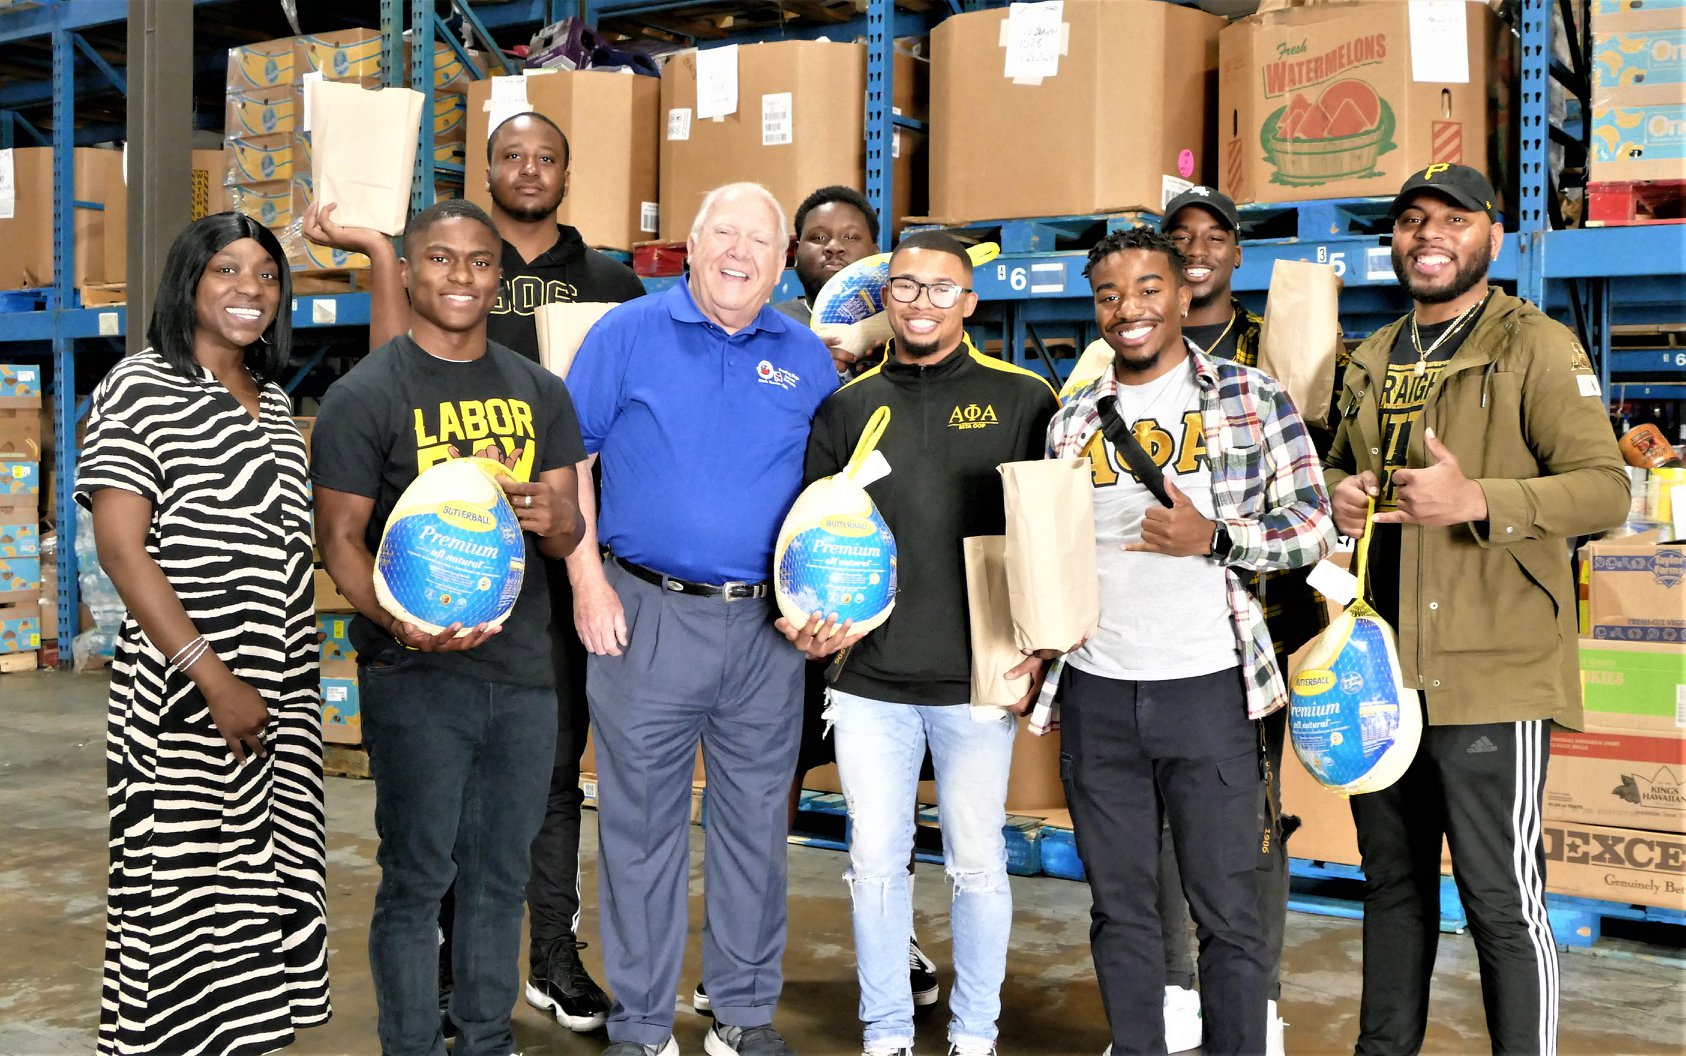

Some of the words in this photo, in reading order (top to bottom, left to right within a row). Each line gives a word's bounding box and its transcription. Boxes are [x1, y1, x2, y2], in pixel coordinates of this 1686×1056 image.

[1276, 38, 1308, 60] Fresh
[1267, 33, 1386, 94] WATERMELONS
[1424, 163, 1449, 180] P
[1319, 248, 1326, 261] 3
[1330, 252, 1346, 277] 5
[1010, 267, 1027, 291] 6
[1675, 353, 1686, 367] 6
[414, 398, 536, 447] LABOR
[442, 505, 492, 525] BUTTERBALL
[825, 519, 868, 531] BUTTERBALL
[418, 525, 500, 560] Premium
[811, 539, 881, 558] Premium
[445, 552, 485, 569] natural
[1654, 555, 1685, 569] Taylor
[1654, 565, 1684, 577] Farms
[1302, 718, 1331, 729] natural
[1604, 873, 1661, 894] Genuinely
